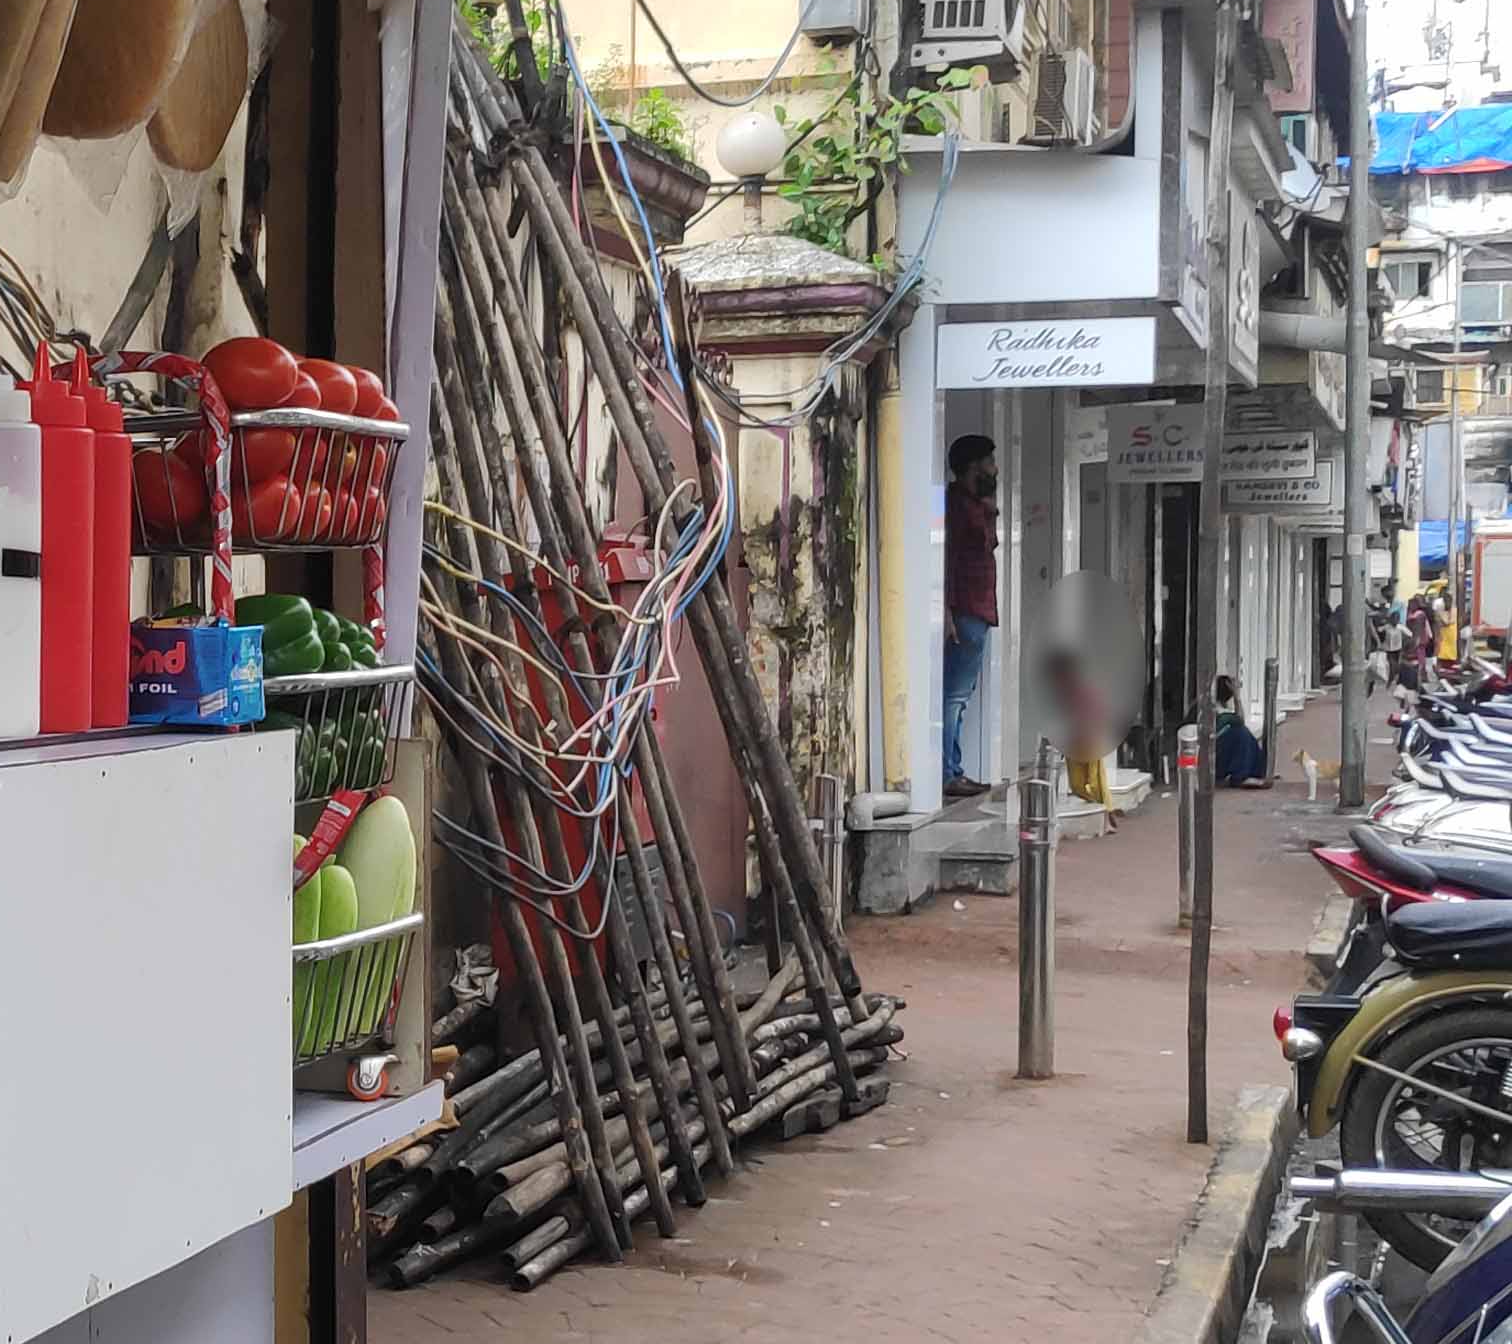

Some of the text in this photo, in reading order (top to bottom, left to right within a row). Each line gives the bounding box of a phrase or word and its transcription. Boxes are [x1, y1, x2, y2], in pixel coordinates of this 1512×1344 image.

[987, 326, 1102, 353] Radhika
[972, 355, 1105, 383] Jewellers
[138, 682, 178, 695] FOIL
